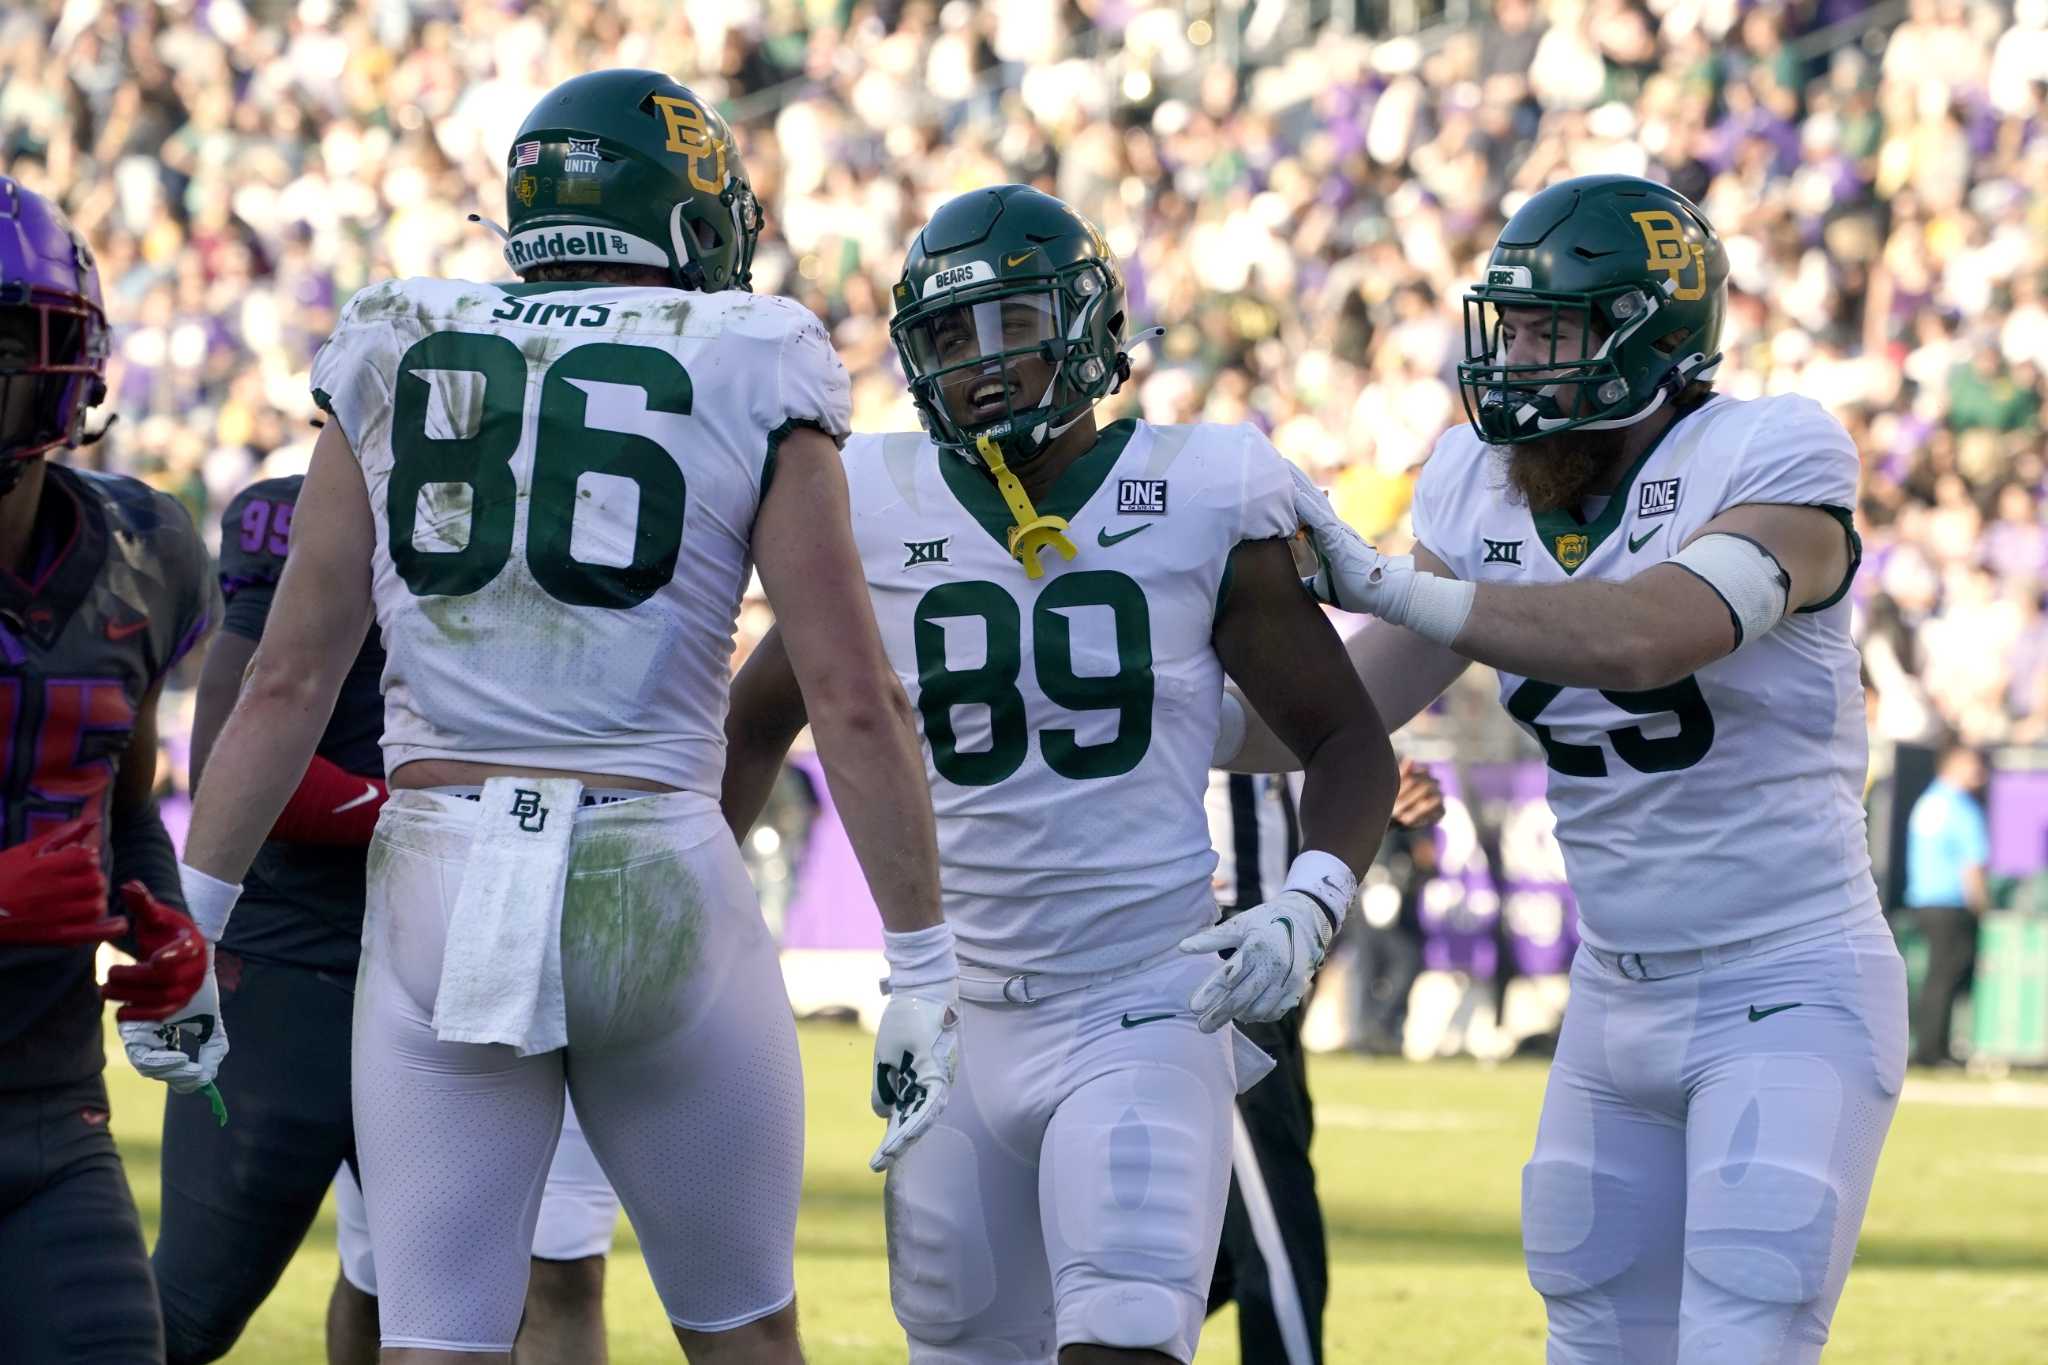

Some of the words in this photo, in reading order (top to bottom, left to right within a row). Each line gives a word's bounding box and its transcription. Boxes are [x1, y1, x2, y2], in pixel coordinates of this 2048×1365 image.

[653, 96, 727, 195] BU
[565, 160, 598, 173] UNITY
[512, 232, 607, 264] Riddell
[611, 235, 628, 254] BU
[1631, 211, 1706, 301] BU
[936, 266, 973, 288] BEARS
[492, 296, 618, 327] SIMS
[388, 331, 693, 609] 86
[1121, 481, 1164, 505] ONE
[1642, 481, 1677, 508] ONE
[240, 500, 292, 556] 95
[914, 570, 1155, 786] 89
[510, 789, 548, 833] BU
